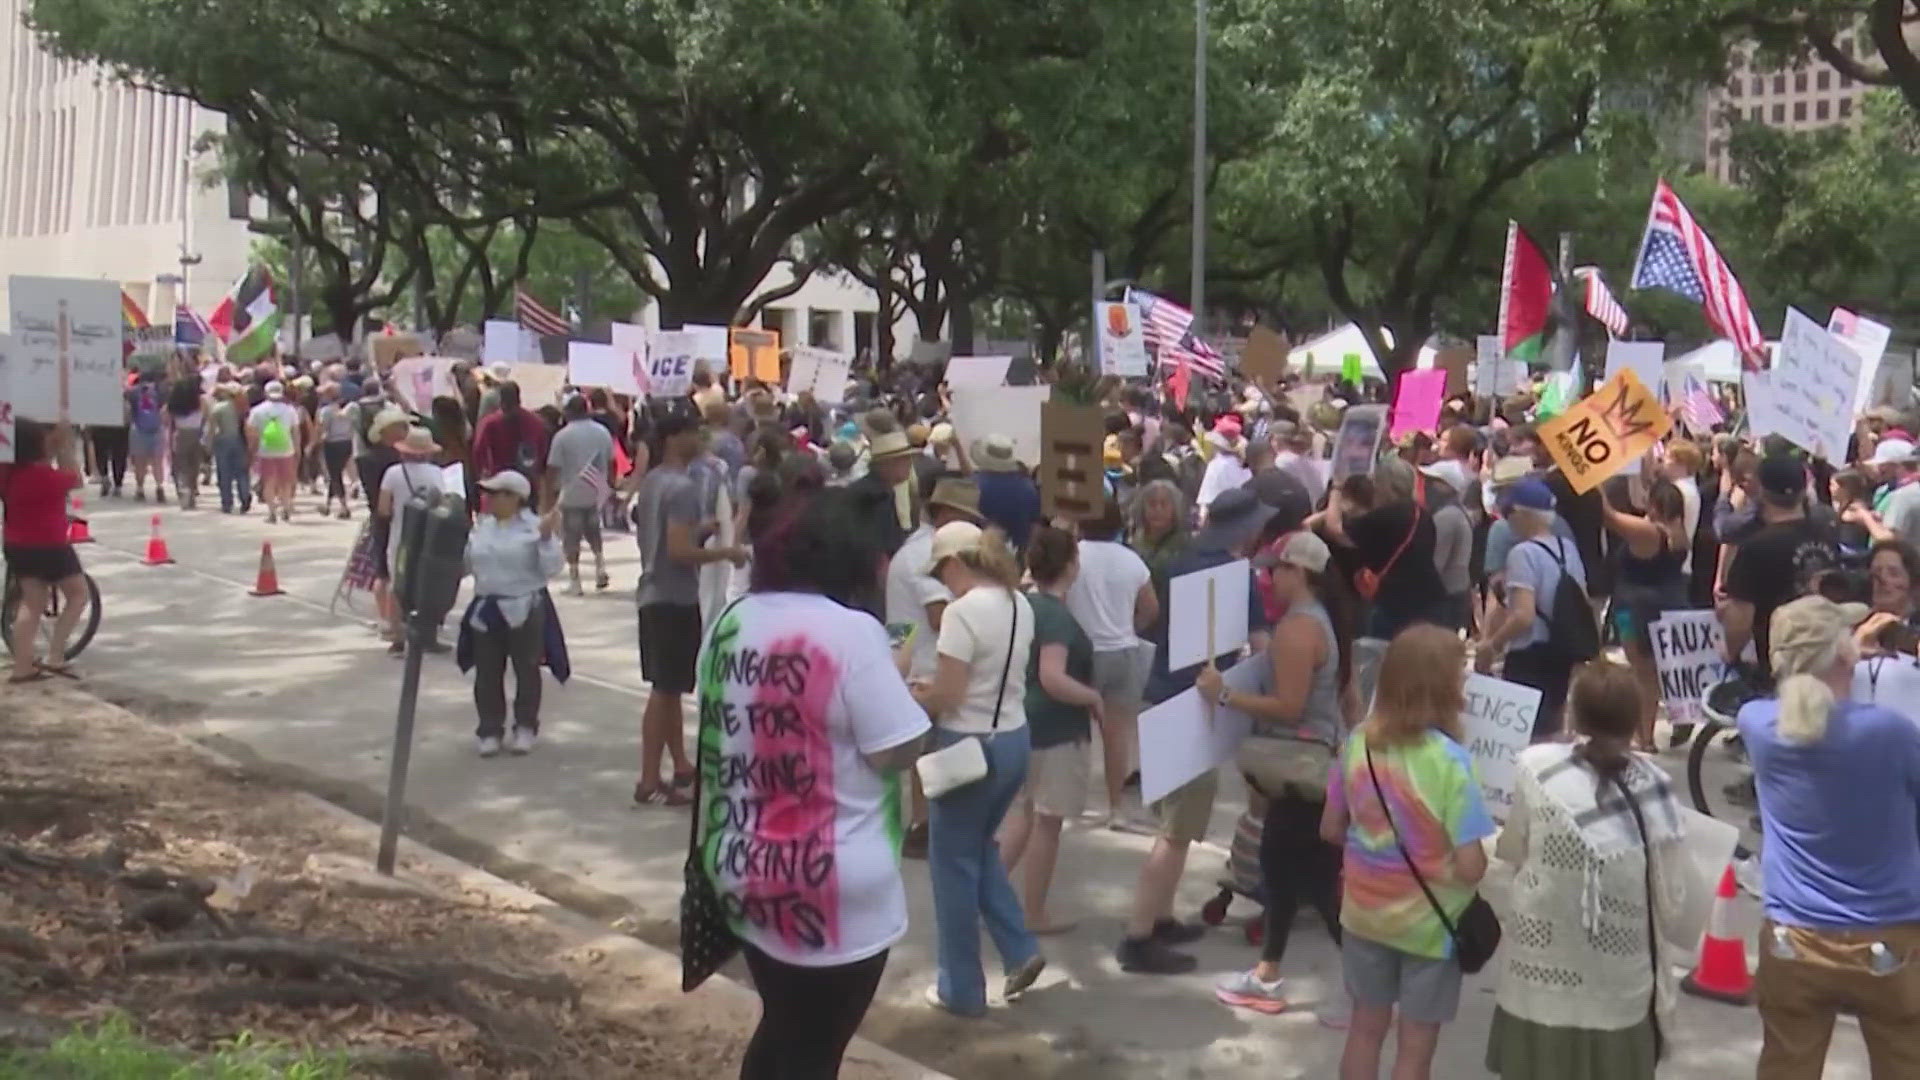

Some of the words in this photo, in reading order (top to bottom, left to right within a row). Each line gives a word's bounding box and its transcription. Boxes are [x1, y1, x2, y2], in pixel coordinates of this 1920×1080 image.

[651, 354, 692, 377] ICE
[1555, 431, 1591, 476] KINGS
[1568, 416, 1611, 465] NO
[708, 626, 811, 696] TONGUES
[745, 702, 807, 739] FOR
[1466, 691, 1532, 734] INGS
[709, 795, 768, 833] OUT
[713, 834, 835, 889] LICKING
[719, 891, 827, 949] OOTS
